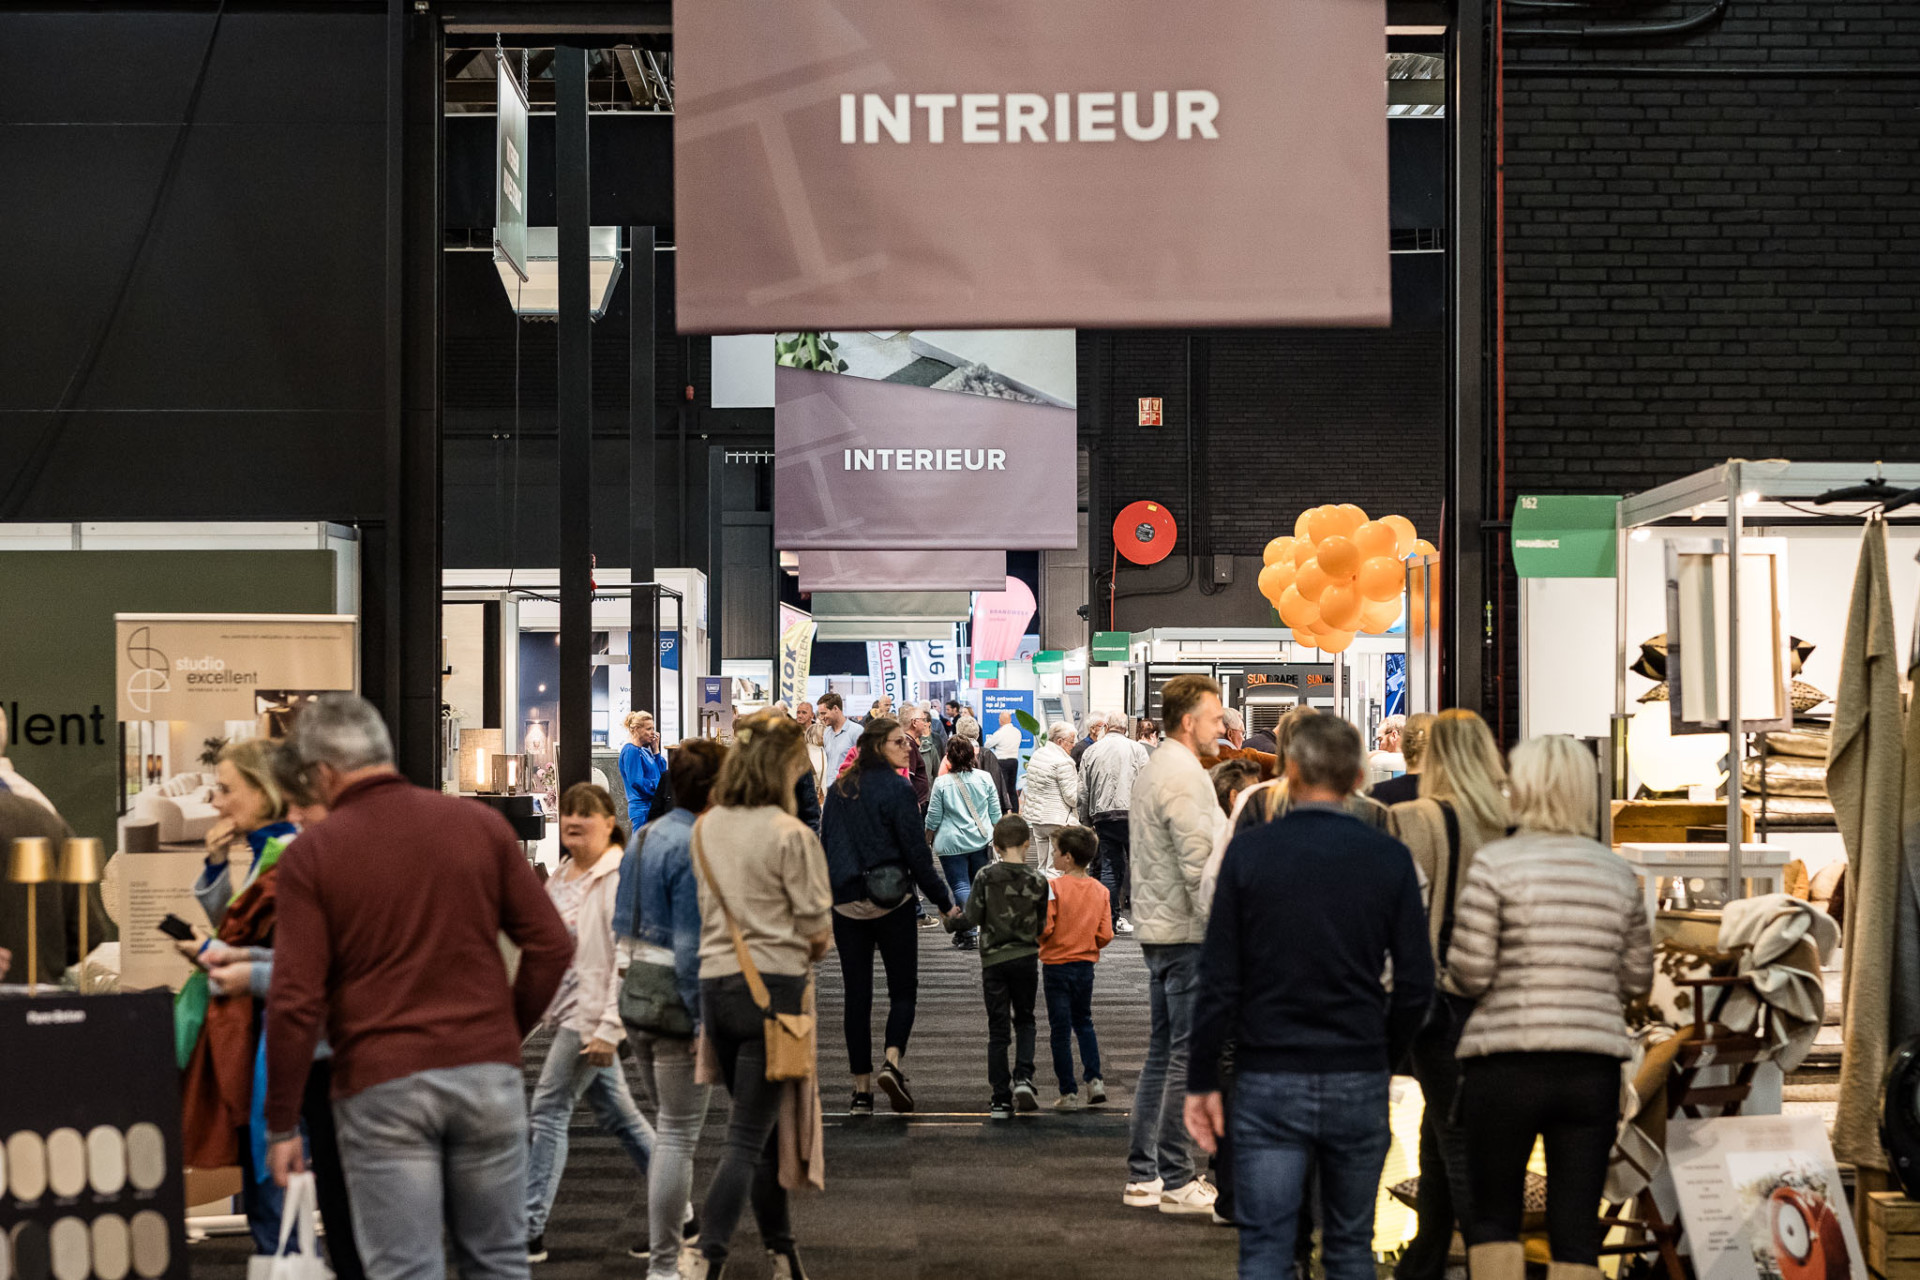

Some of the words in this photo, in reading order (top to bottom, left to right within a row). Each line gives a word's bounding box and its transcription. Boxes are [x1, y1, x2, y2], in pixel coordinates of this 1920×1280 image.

[840, 90, 1220, 143] INTERIEUR
[844, 449, 1006, 471] INTERIEUR
[1521, 497, 1538, 509] 162
[176, 656, 225, 671] studio
[187, 670, 258, 684] excellent
[1247, 673, 1298, 684] SUNDRAPE
[0, 701, 105, 745] lent
